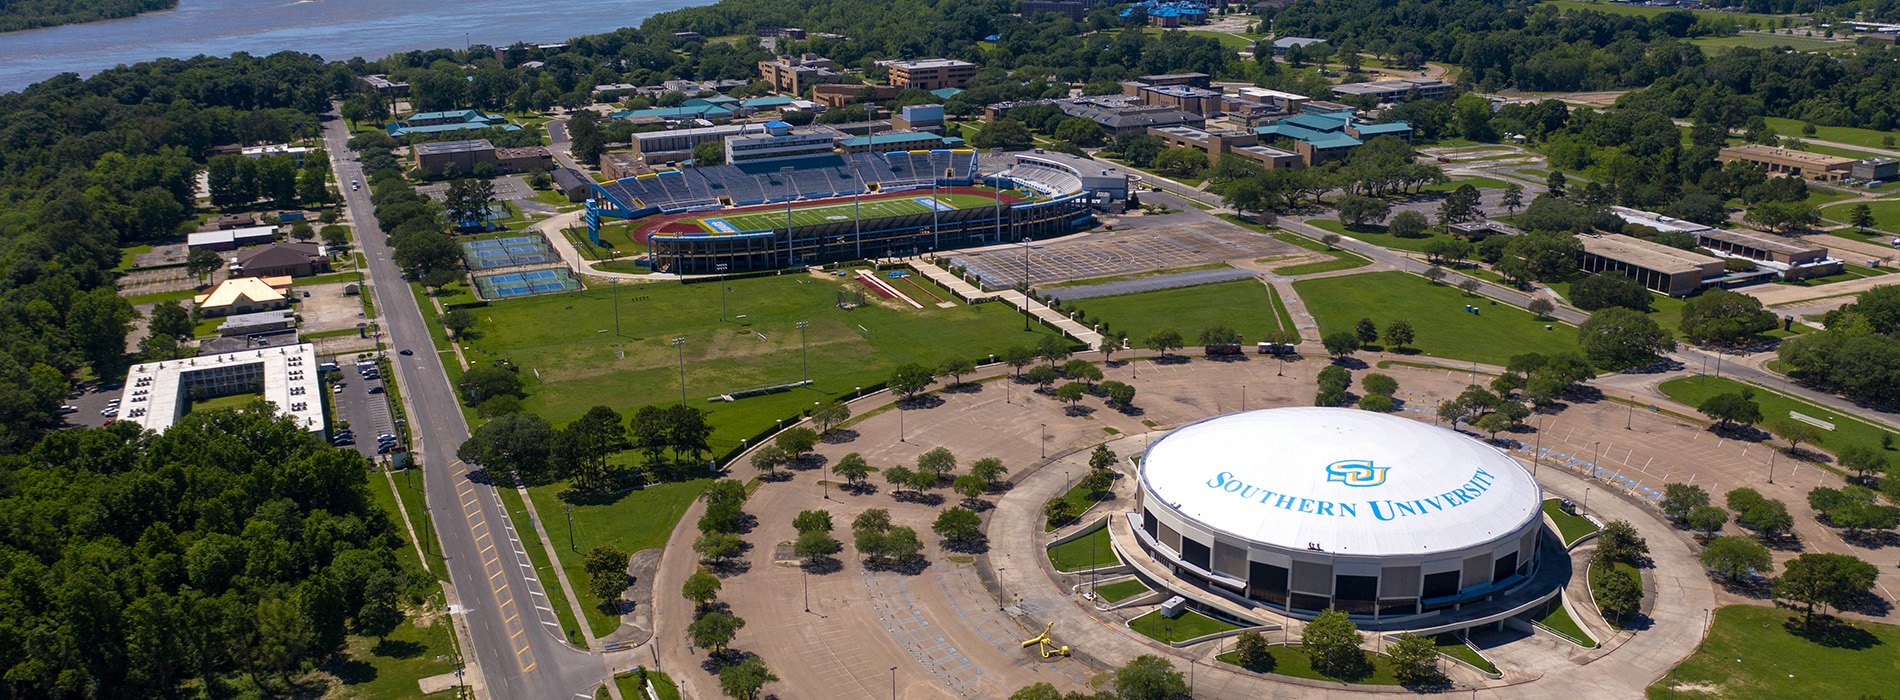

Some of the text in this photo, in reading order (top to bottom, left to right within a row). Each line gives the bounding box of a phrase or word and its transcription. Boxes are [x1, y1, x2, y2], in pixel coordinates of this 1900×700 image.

[1326, 459, 1392, 487] SU
[1206, 467, 1495, 521] SOUTHERN UNIVERSITY
